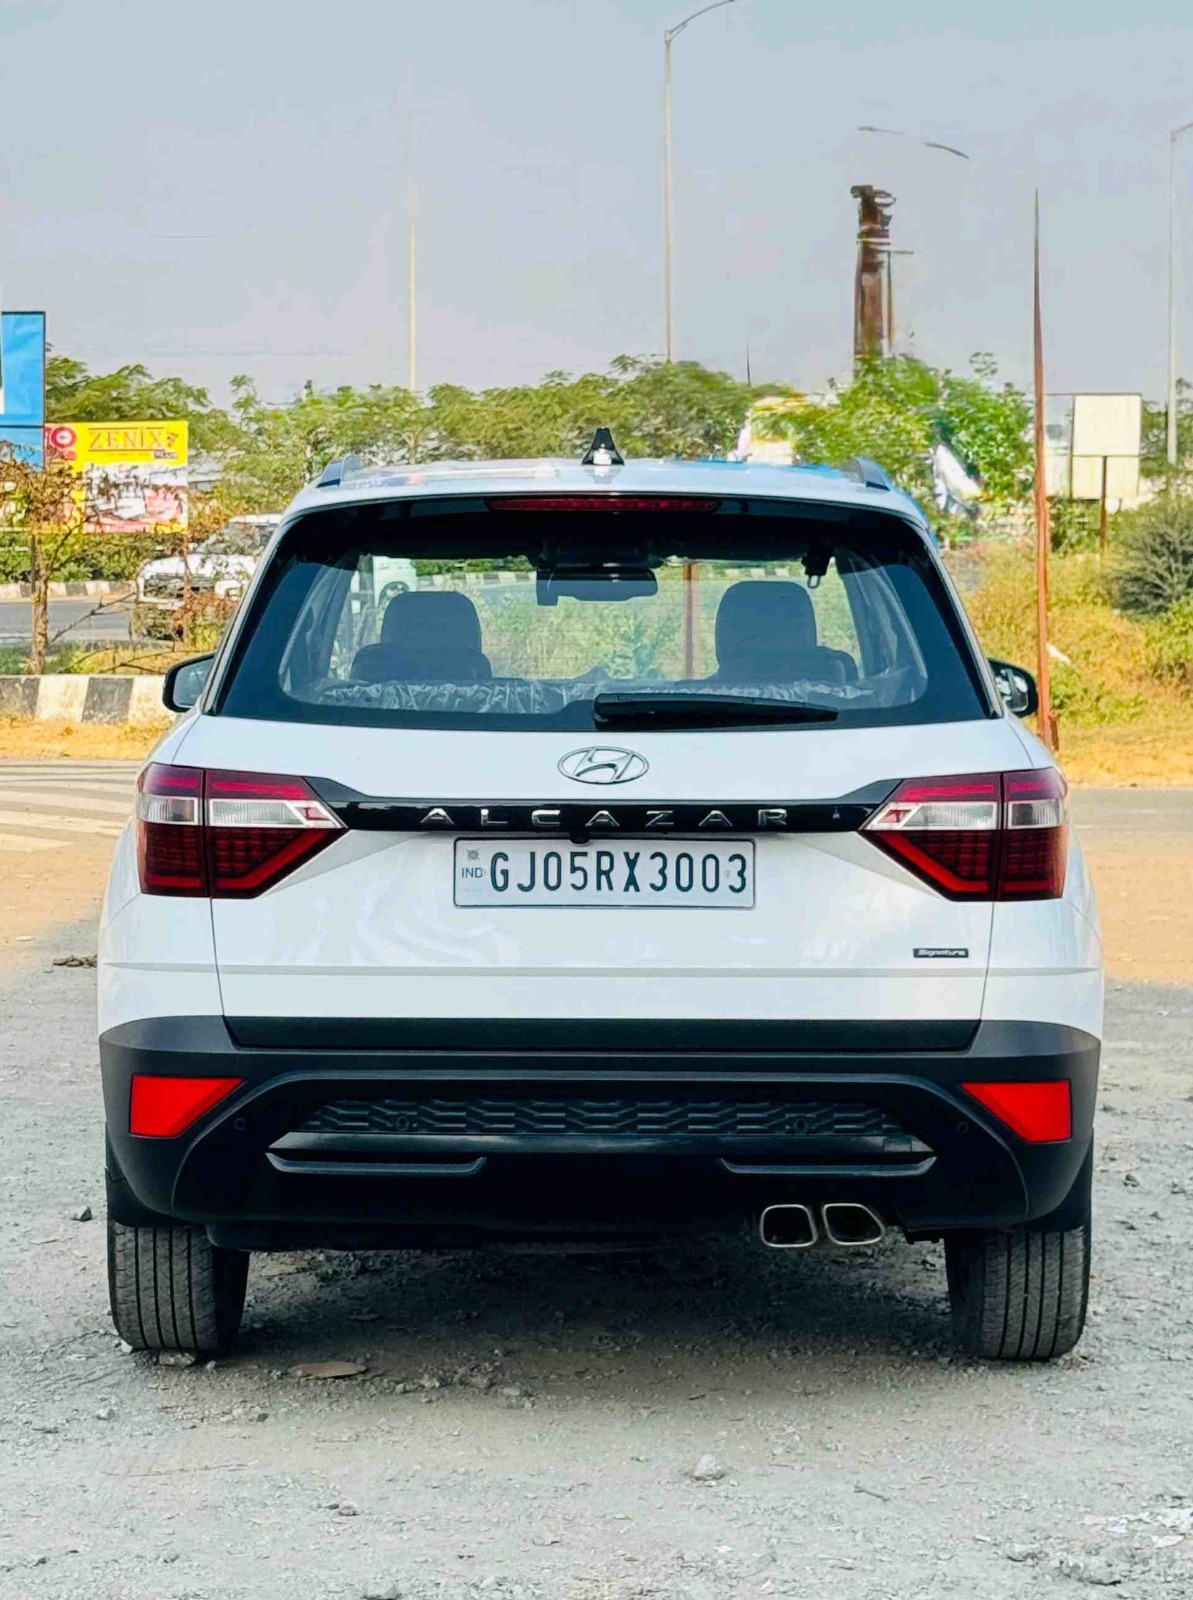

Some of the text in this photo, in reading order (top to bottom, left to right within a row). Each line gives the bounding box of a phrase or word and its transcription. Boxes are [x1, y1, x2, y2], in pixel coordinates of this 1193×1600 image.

[420, 807, 788, 828] ALCAZAR
[461, 867, 484, 879] IND
[490, 851, 747, 894] GJ05RX3003
